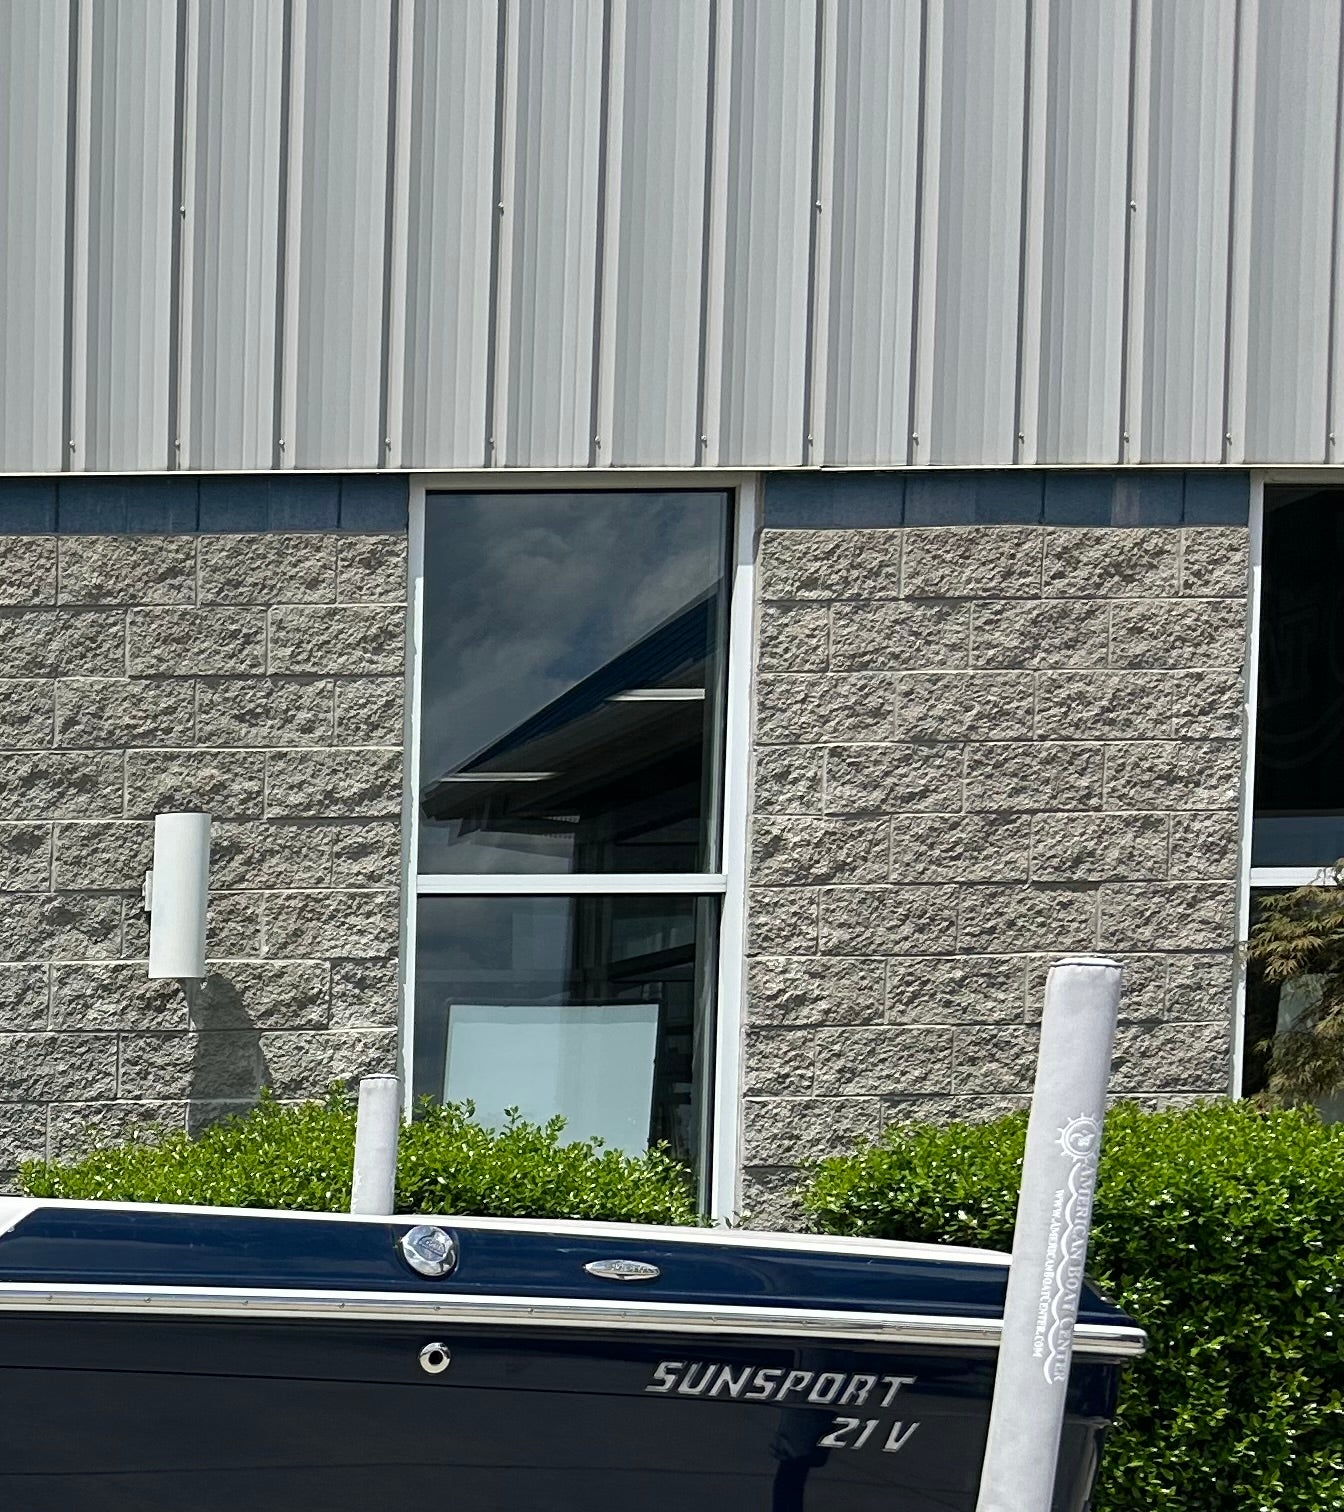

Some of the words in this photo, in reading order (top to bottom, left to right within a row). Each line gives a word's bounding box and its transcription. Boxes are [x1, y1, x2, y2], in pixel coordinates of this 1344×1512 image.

[1070, 1162, 1095, 1259] AMERICAN
[1062, 1266, 1081, 1311] BOAT
[1053, 1317, 1072, 1381] CENTER
[644, 1360, 917, 1408] SUNSPORT
